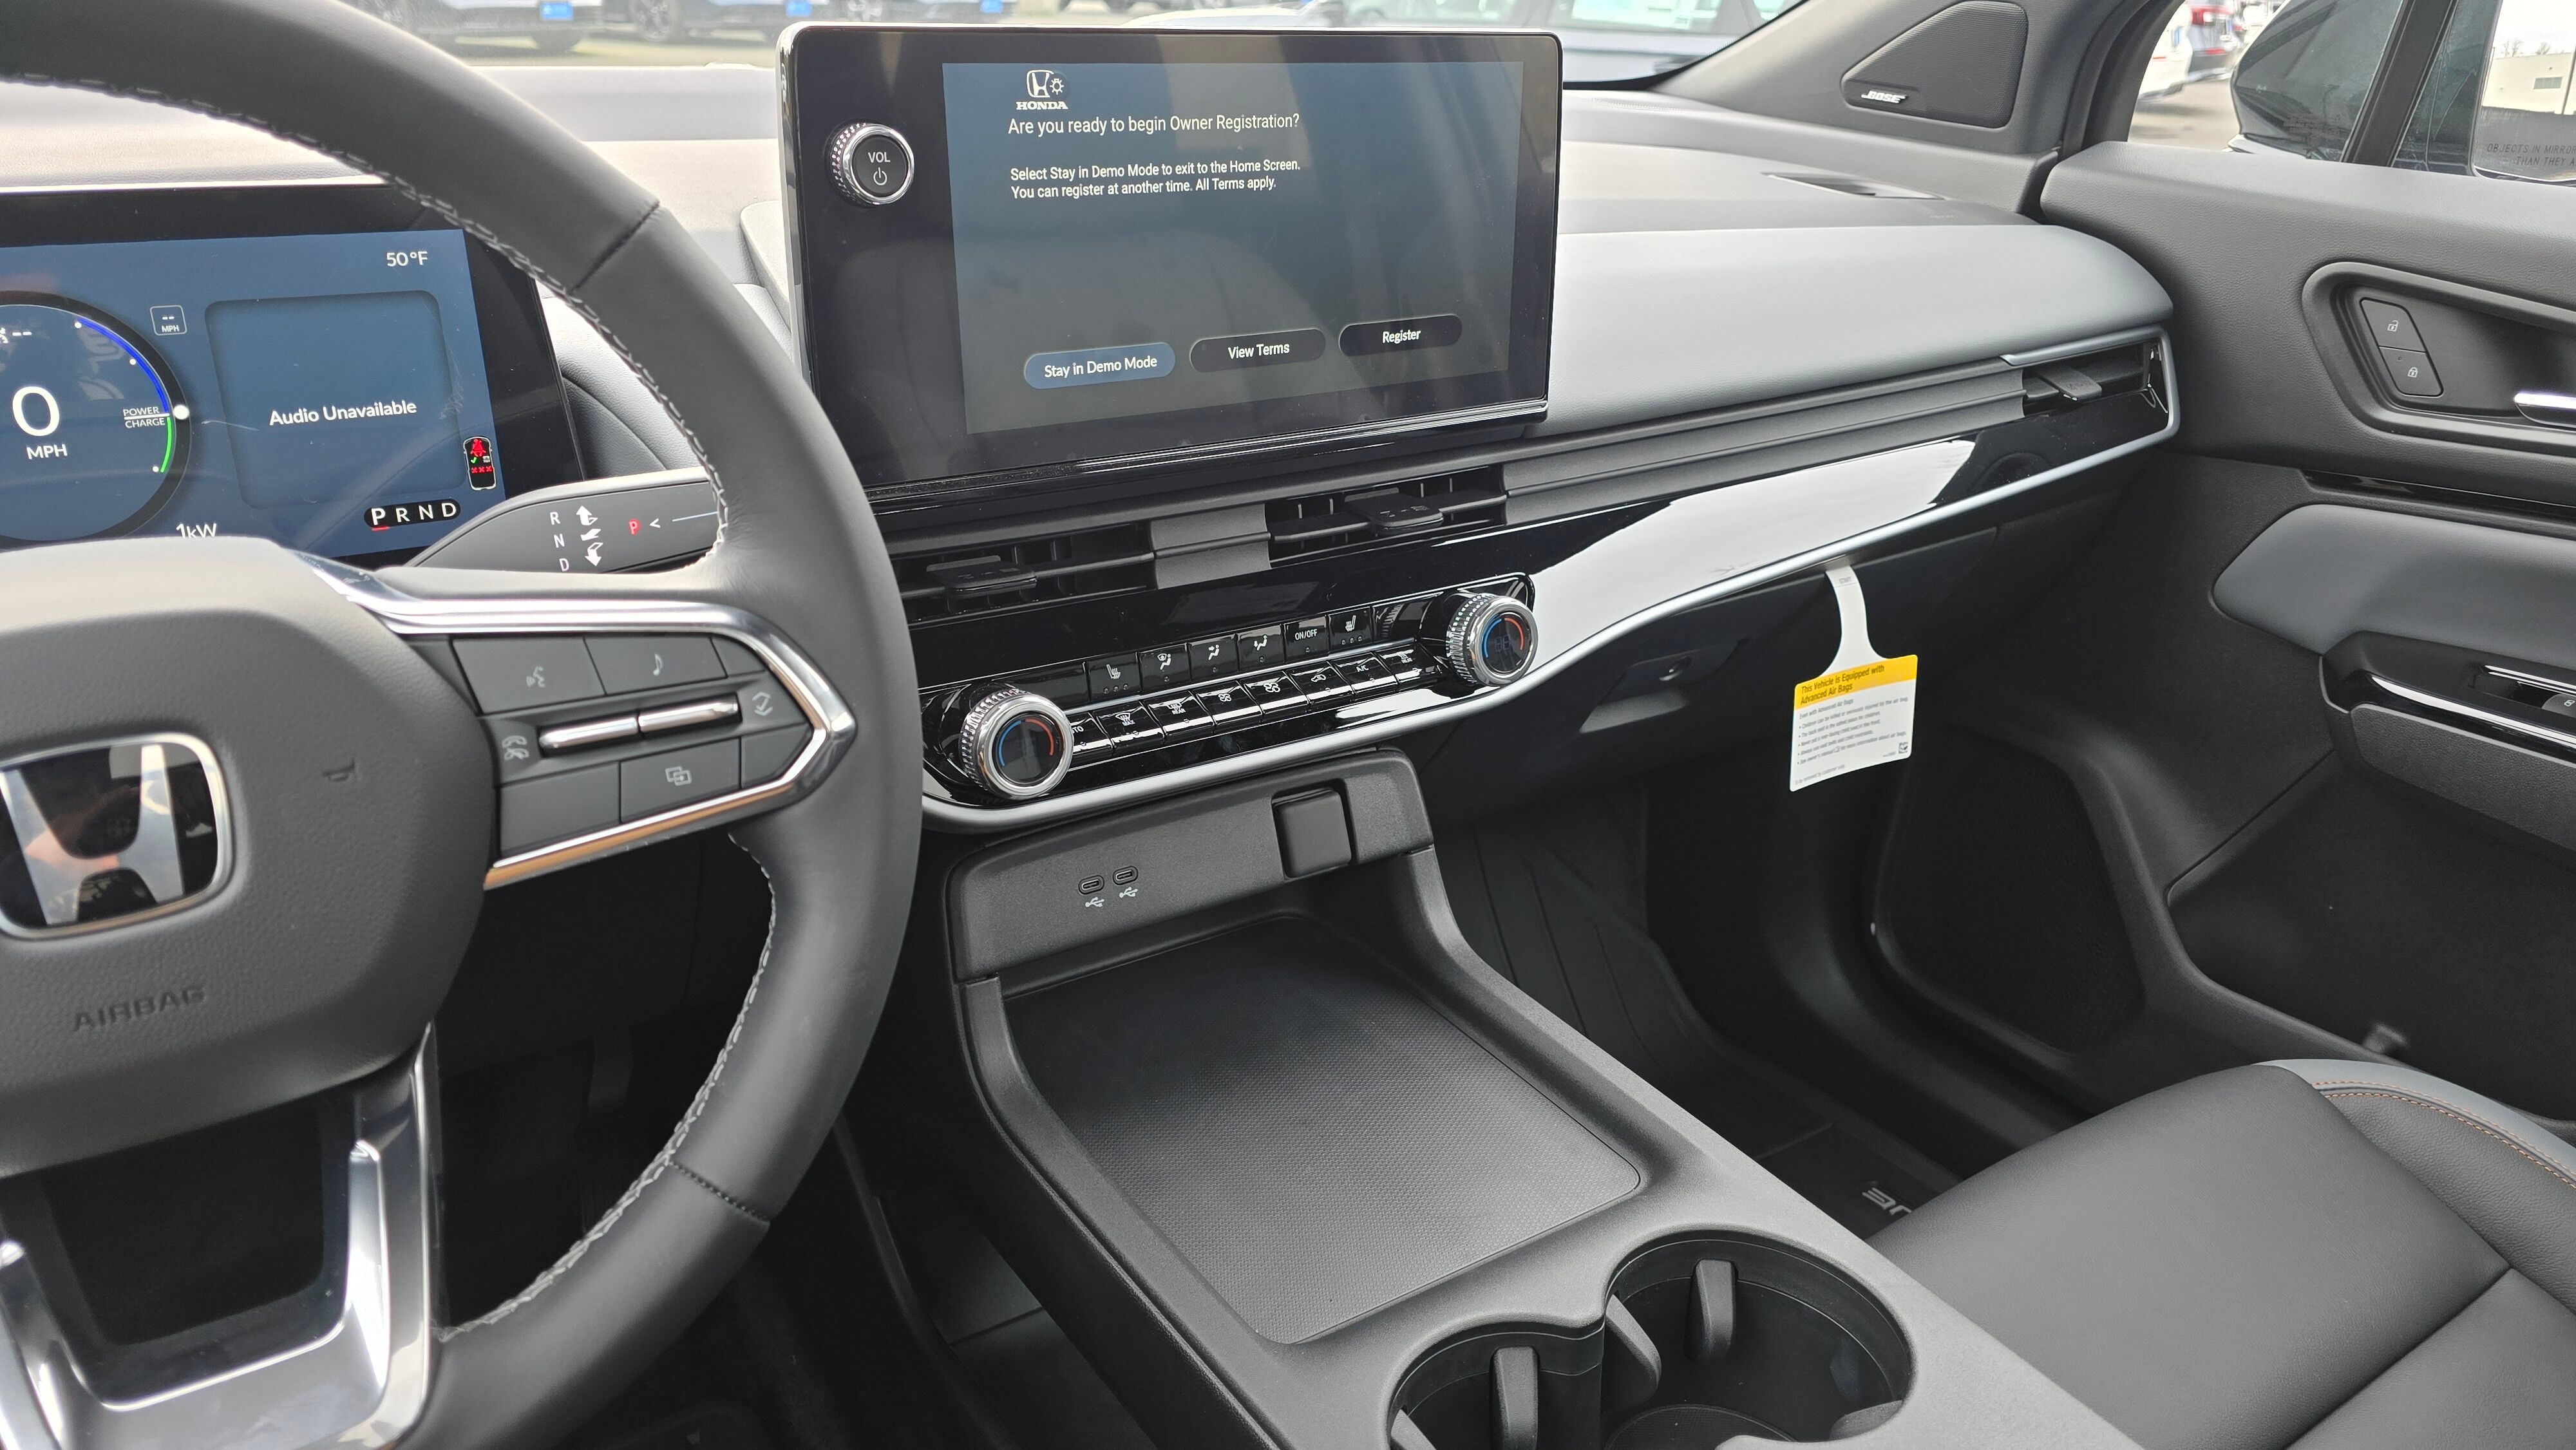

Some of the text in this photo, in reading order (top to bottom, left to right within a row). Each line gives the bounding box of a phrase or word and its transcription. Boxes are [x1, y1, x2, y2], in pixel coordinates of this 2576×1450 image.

[1861, 91, 1908, 104] BOSE
[1016, 101, 1068, 111] HONDA
[1008, 113, 1300, 137] Are you ready to begin Owner Registration?
[2486, 143, 2529, 153] OBJECTS
[2532, 144, 2541, 153] IN
[868, 151, 891, 164] VOL
[2516, 156, 2541, 165] THAN
[2544, 156, 2566, 166] THEY
[1010, 158, 1301, 182] Select Stay in Demo Mode to exit to the Home Screen.
[1011, 176, 1276, 200] You can register at another time. All Terms apply.
[386, 250, 428, 268] 50°F
[161, 325, 180, 333] MPH
[1382, 328, 1421, 344] Register
[1228, 341, 1290, 359] View Terms
[1044, 355, 1158, 379] Stay in Demo Mode
[12, 386, 60, 437] 0
[123, 406, 160, 417] POWER
[269, 400, 417, 426] Audio Unavailable
[124, 417, 166, 429] CHARGE
[26, 444, 68, 460] MPH
[371, 502, 457, 525] P R N D
[550, 511, 561, 525] R
[176, 523, 217, 539] 1kW
[629, 520, 639, 535] P
[554, 533, 565, 548] N
[559, 558, 569, 572] D
[1295, 628, 1318, 641] ON/OFF
[1356, 664, 1369, 673] A/C
[1801, 685, 1813, 694] This
[1814, 678, 1834, 689] Vehicle
[1842, 668, 1870, 682] Equipped
[1871, 664, 1885, 674] with
[1801, 683, 1853, 705] Advanced Air Bags
[1072, 726, 1084, 734] TO
[73, 985, 206, 1032] AIRBAG
